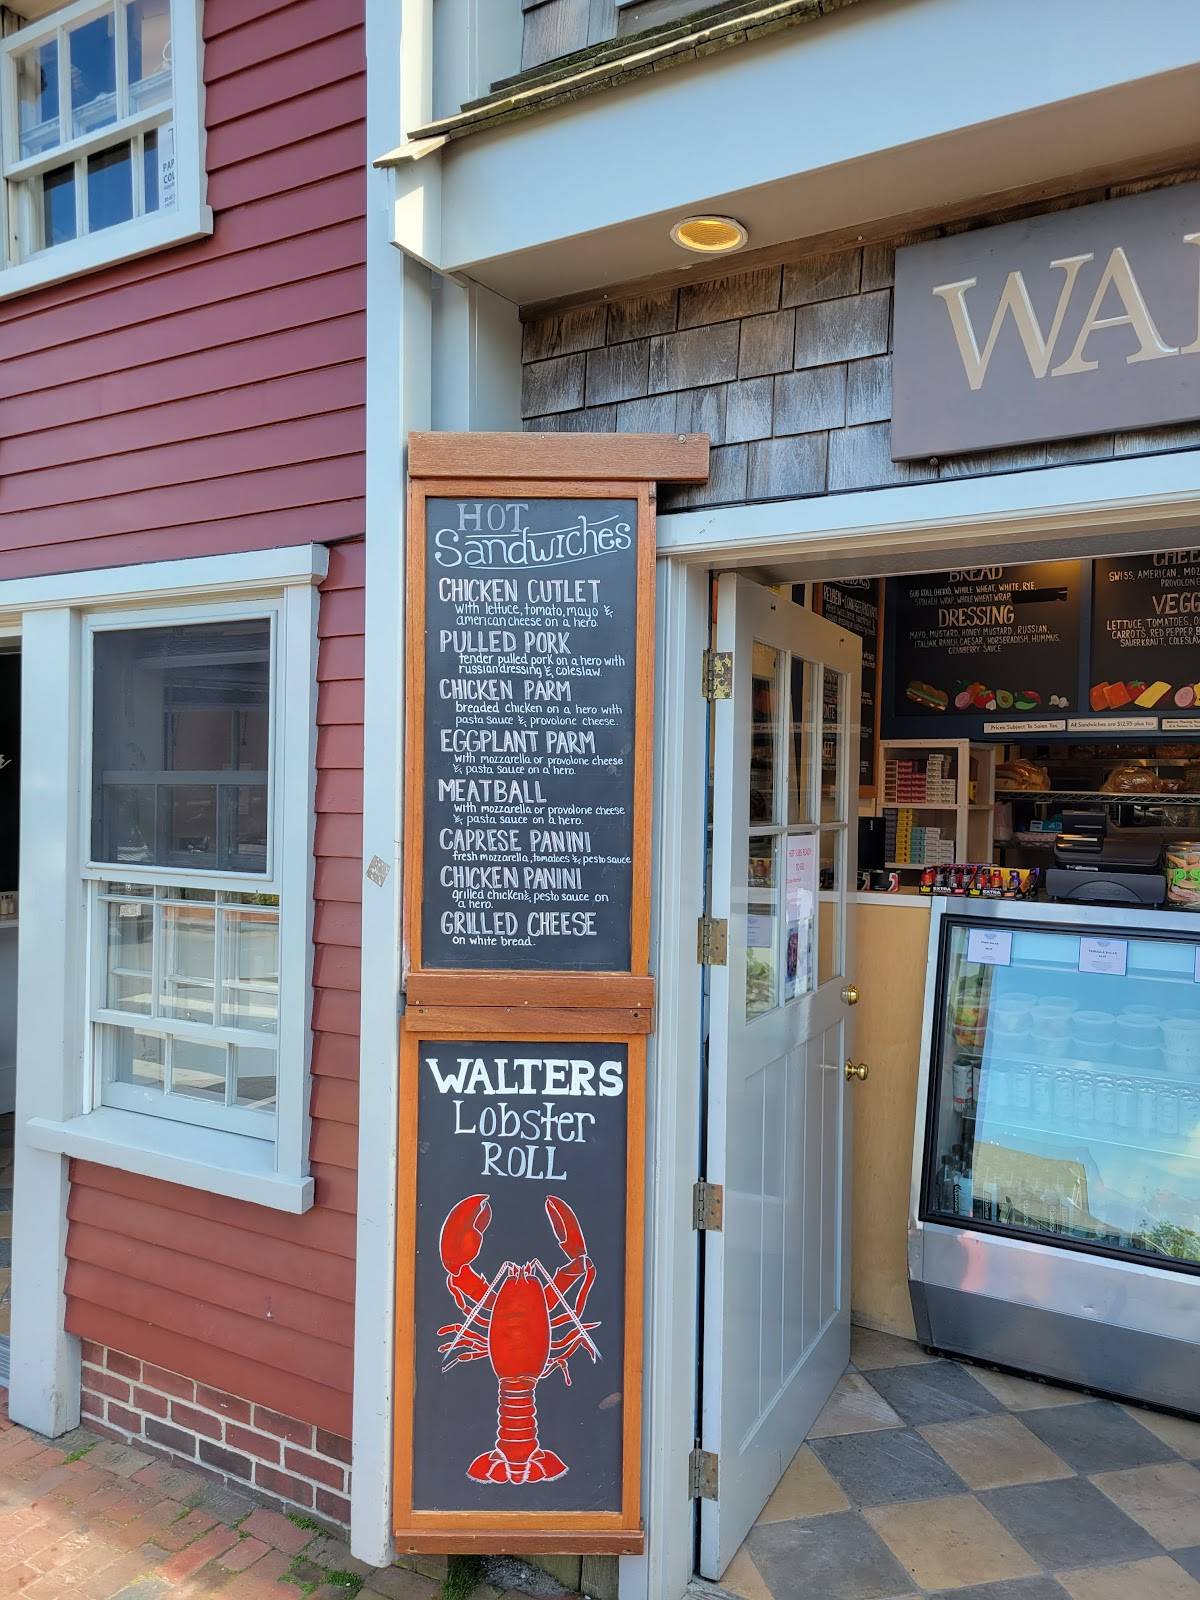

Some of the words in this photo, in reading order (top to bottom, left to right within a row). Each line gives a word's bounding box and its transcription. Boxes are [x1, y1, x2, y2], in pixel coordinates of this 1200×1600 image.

[932, 232, 1200, 391] WA
[457, 503, 529, 532] HOT
[434, 514, 632, 568] Sandwiches
[439, 577, 518, 602] CHICKEN
[527, 579, 601, 604] CUTLET
[454, 603, 480, 614] with
[485, 603, 523, 616] lettuce,
[524, 604, 566, 617] tomato,
[566, 607, 599, 621] mayo
[603, 605, 614, 618] &
[456, 615, 506, 627] american
[507, 616, 542, 627] cheese
[545, 618, 559, 627] on
[563, 618, 571, 627] a
[573, 616, 599, 628] hero.
[938, 604, 1015, 628] DRESSING
[440, 629, 517, 653] PULLED
[524, 631, 571, 654] PORK
[961, 628, 981, 637] HONEY
[458, 652, 494, 664] tender
[497, 653, 529, 667] pulled
[530, 654, 554, 667] pork
[556, 656, 568, 665] on
[571, 656, 579, 665] a
[580, 655, 602, 666] hero
[604, 655, 625, 667] with
[458, 664, 499, 674] russian
[500, 663, 542, 678] dressing
[439, 678, 513, 701] CHICKEN
[523, 680, 572, 702] PARM
[456, 701, 499, 713] breaded
[505, 702, 543, 714] chicken
[546, 705, 560, 714] on
[563, 706, 572, 715] a
[575, 704, 598, 715] hero
[601, 704, 623, 715] with
[455, 715, 484, 727] pasta
[486, 716, 514, 725] sauce
[517, 715, 528, 728] &
[530, 716, 577, 728] provolone
[582, 716, 620, 726] cheese.
[440, 729, 539, 753] EGGPLANT
[545, 730, 596, 754] PARM
[452, 763, 463, 774] &
[465, 764, 494, 776] pasta
[497, 764, 525, 774] sauce
[527, 766, 540, 775] on
[542, 766, 551, 775] a
[553, 765, 577, 775] hero.
[454, 752, 476, 764] with
[480, 753, 531, 764] mozzarella
[533, 755, 544, 764] or
[547, 755, 589, 767] provolone
[591, 755, 624, 766] cheese
[438, 779, 548, 804] MEATBALL
[454, 803, 477, 814] with
[480, 804, 532, 815] mozzarella
[534, 805, 545, 815] or
[548, 804, 593, 817] provolone
[595, 805, 626, 816] cheese
[466, 814, 497, 827] pasta
[499, 815, 528, 825] sauce
[532, 816, 545, 825] on
[548, 816, 557, 826] a
[558, 815, 584, 826] hero.
[439, 828, 522, 852] CAPRESE
[529, 829, 591, 853] PANINI
[452, 850, 478, 862] fresh
[582, 854, 606, 867] pesto
[606, 855, 632, 864] sauce
[439, 866, 519, 889] CHICKEN
[523, 868, 582, 890] PANINI
[452, 889, 484, 903] grilled
[487, 889, 524, 901] chicken
[533, 891, 560, 903] pesto
[561, 892, 590, 902] sauce
[594, 893, 609, 902] on
[457, 900, 466, 909] a
[468, 899, 494, 909] hero.
[440, 911, 519, 935] GRILLED
[526, 912, 598, 936] CHEESE
[452, 936, 466, 945] on
[469, 936, 498, 946] white
[501, 935, 536, 946] bread.
[425, 1058, 624, 1097] WALTERS
[452, 1100, 596, 1143] Lobster
[481, 1142, 567, 1181] ROLL
